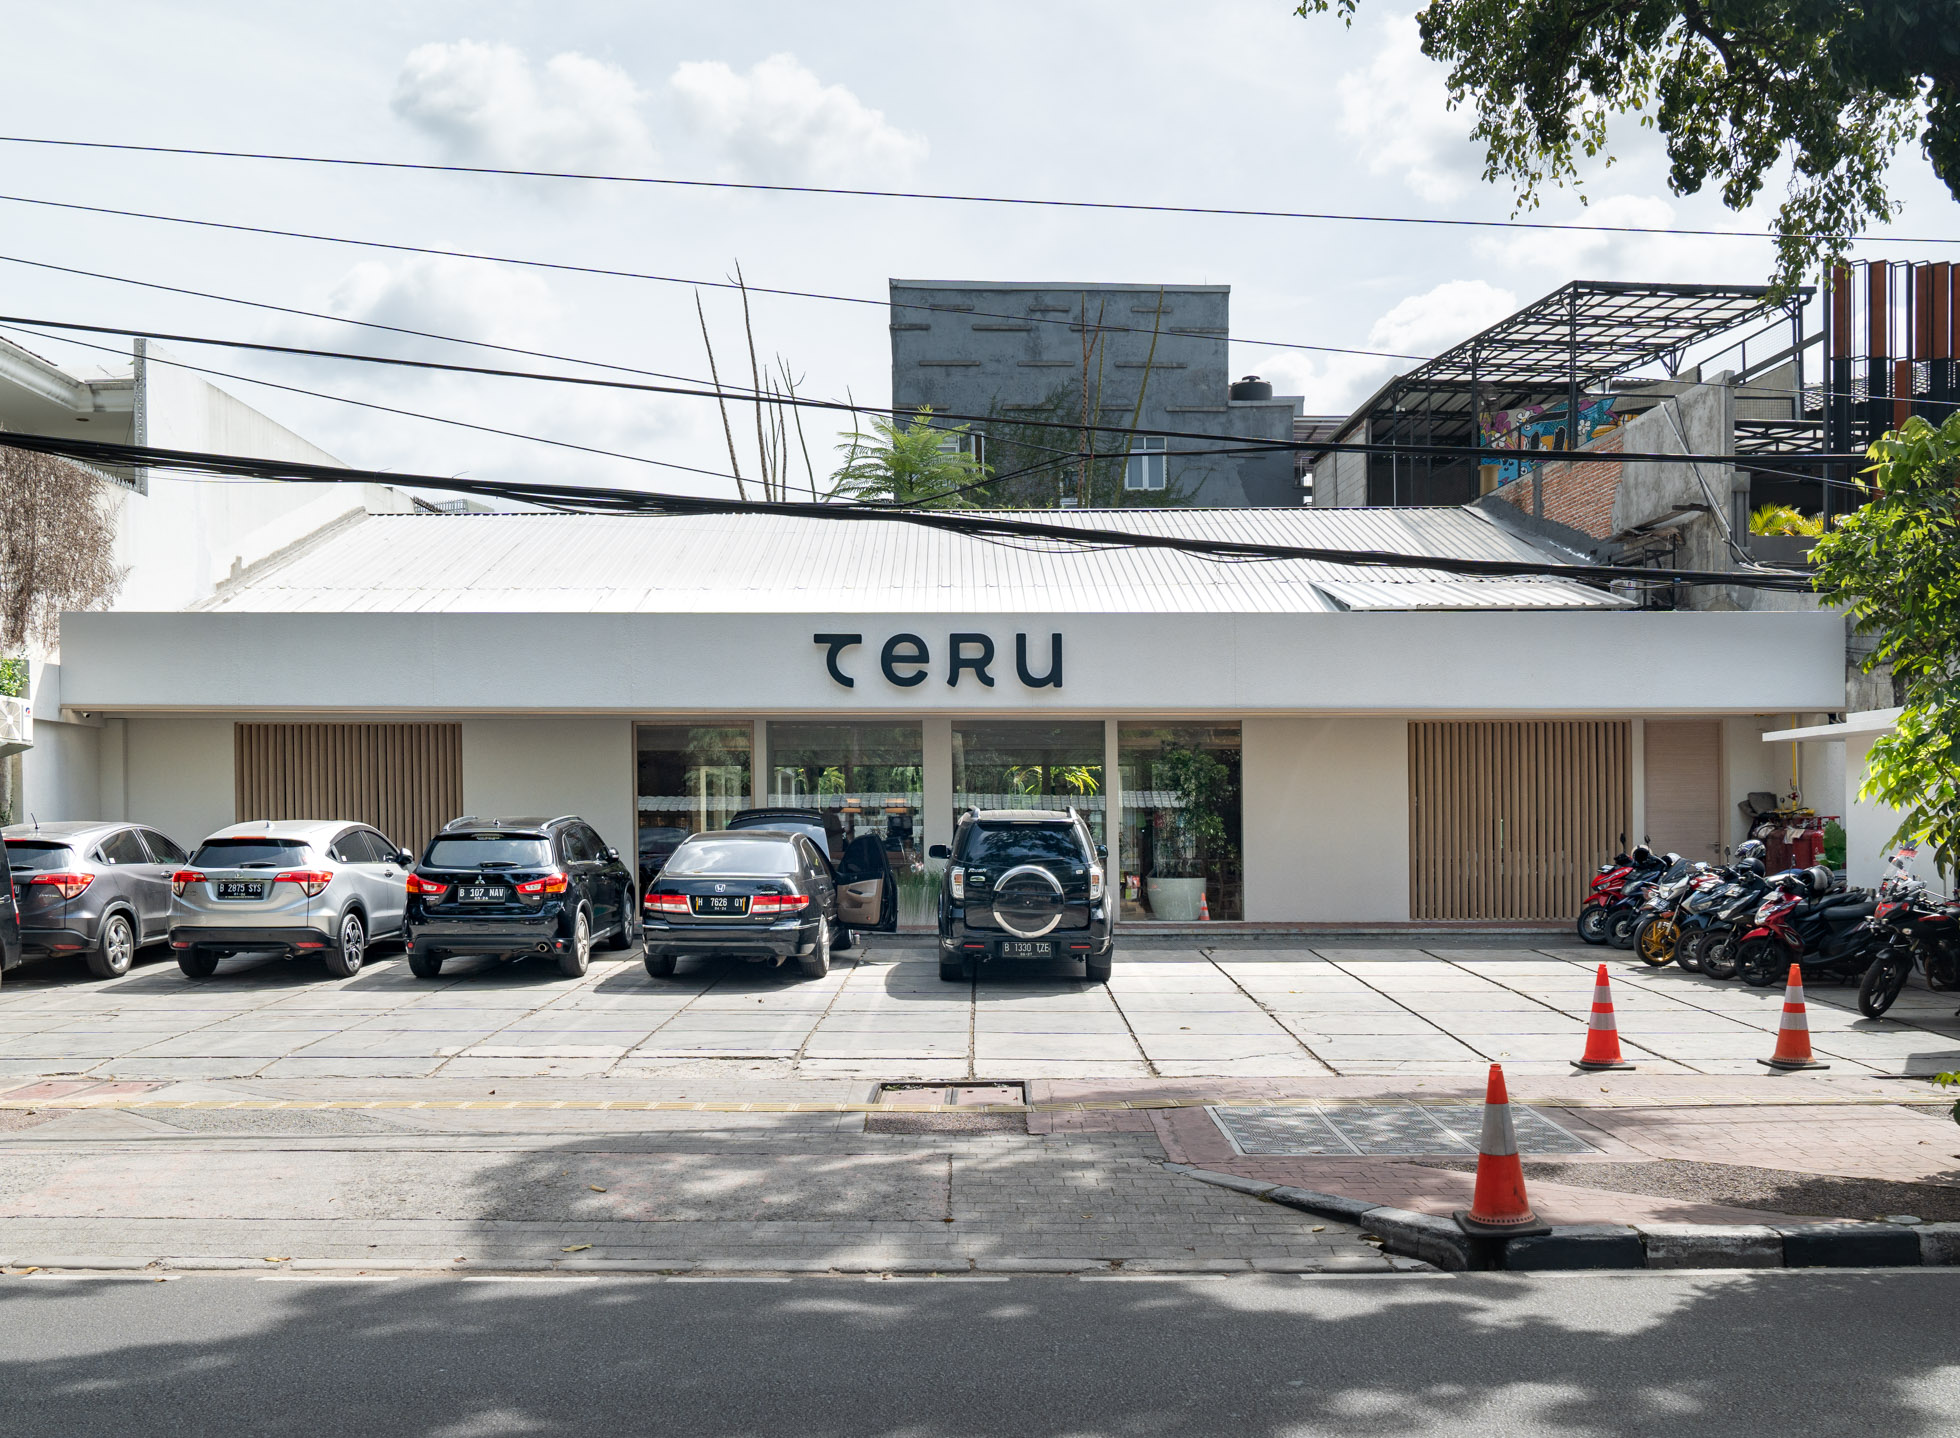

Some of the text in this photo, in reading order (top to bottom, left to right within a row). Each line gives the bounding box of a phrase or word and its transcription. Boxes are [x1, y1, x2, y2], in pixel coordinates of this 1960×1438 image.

[219, 883, 262, 892] B 2875 SYS
[459, 888, 504, 897] B 107 NAV
[710, 897, 728, 907] 7626
[1004, 943, 1050, 953] B 1330 TZE
